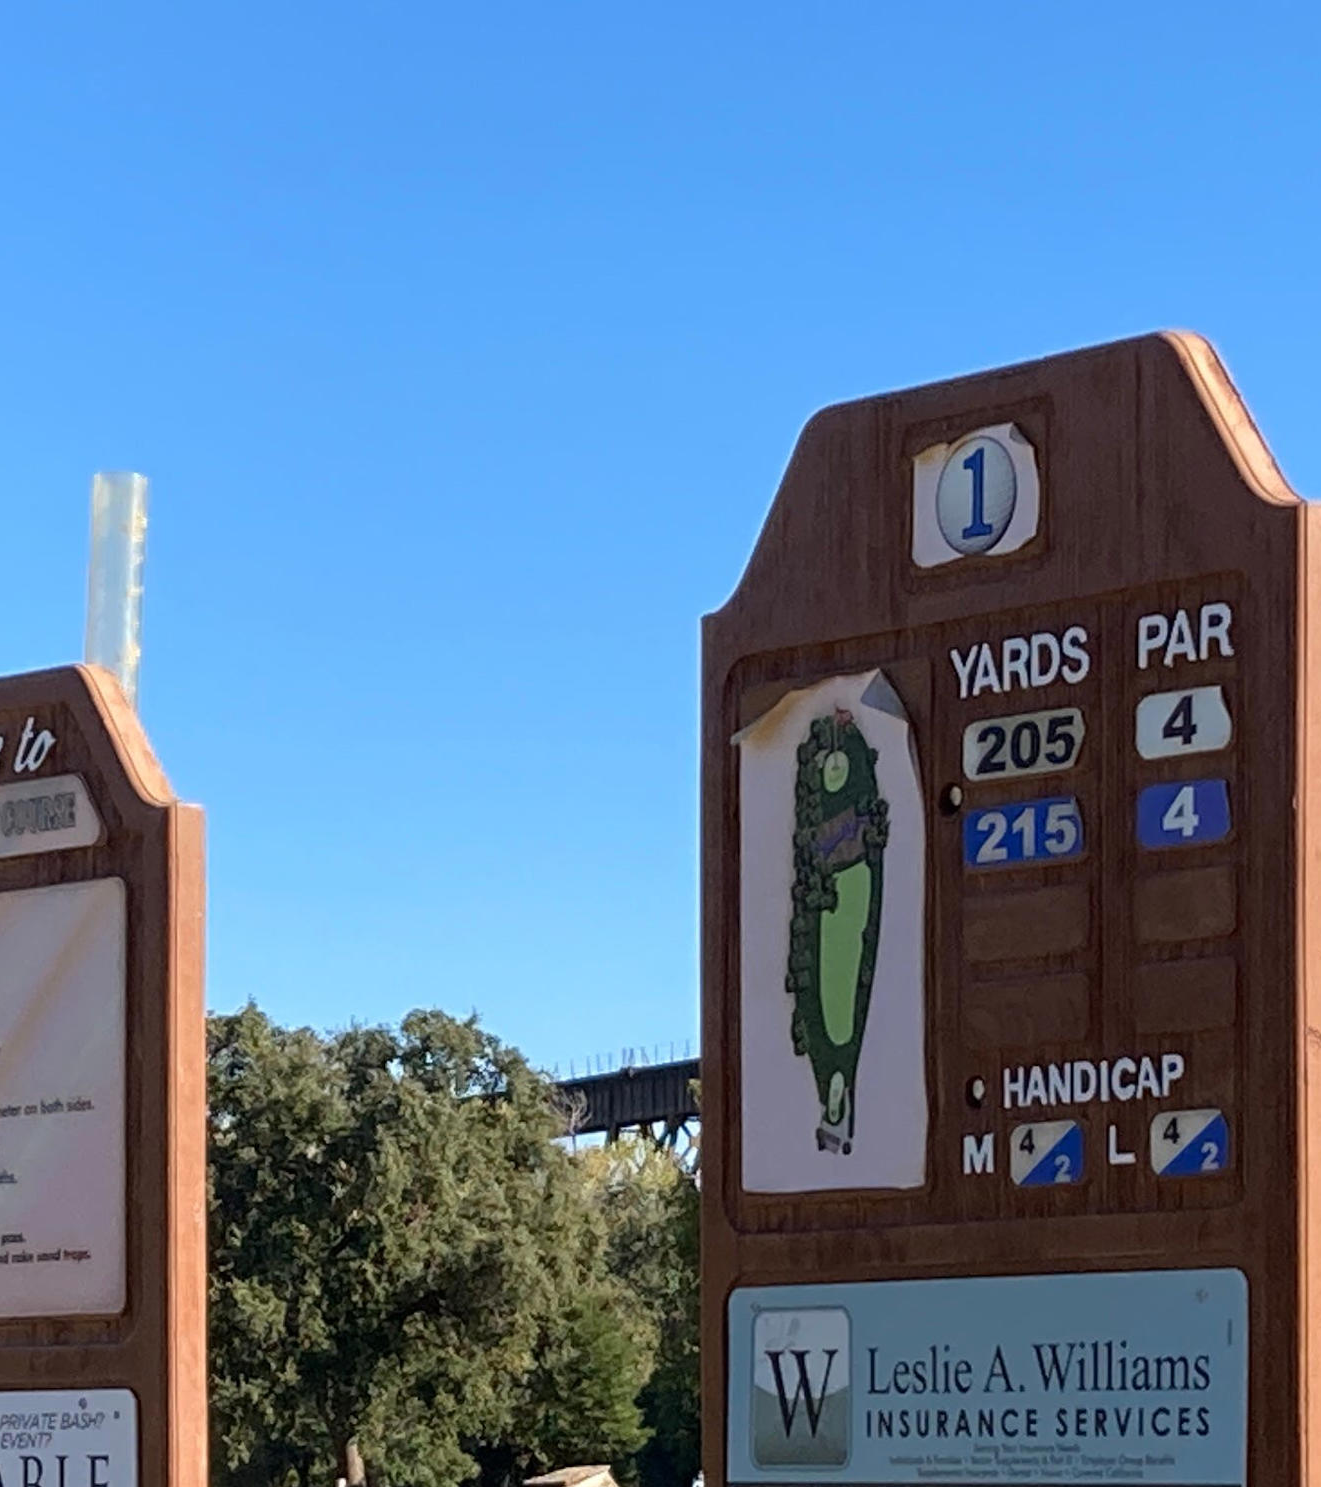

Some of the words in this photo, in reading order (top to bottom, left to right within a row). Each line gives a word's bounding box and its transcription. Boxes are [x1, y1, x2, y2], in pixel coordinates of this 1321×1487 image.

[961, 447, 994, 539] 1
[950, 626, 1091, 700] YARDS
[1138, 602, 1235, 669] PAR
[13, 716, 56, 773] to
[976, 715, 1076, 775] 205
[1162, 695, 1197, 747] 4
[976, 804, 1077, 863] 215
[1162, 786, 1199, 837] 4
[1003, 1053, 1185, 1109] HANDICAP
[963, 1132, 995, 1175] M
[1020, 1128, 1035, 1155] 4
[1108, 1124, 1137, 1165] L
[1162, 1117, 1180, 1144] 4
[1053, 1154, 1072, 1183] 2
[1200, 1141, 1219, 1171] 2
[764, 1348, 840, 1440] W
[866, 1344, 973, 1396] Leslie
[983, 1345, 1026, 1394] A.
[1034, 1339, 1211, 1392] Williams
[0, 1411, 57, 1431] PRIVATE
[60, 1411, 106, 1430] BASH?
[0, 1431, 53, 1450] EVENT?
[866, 1407, 1039, 1439] INSURANCE
[1055, 1406, 1211, 1438] SERVICES
